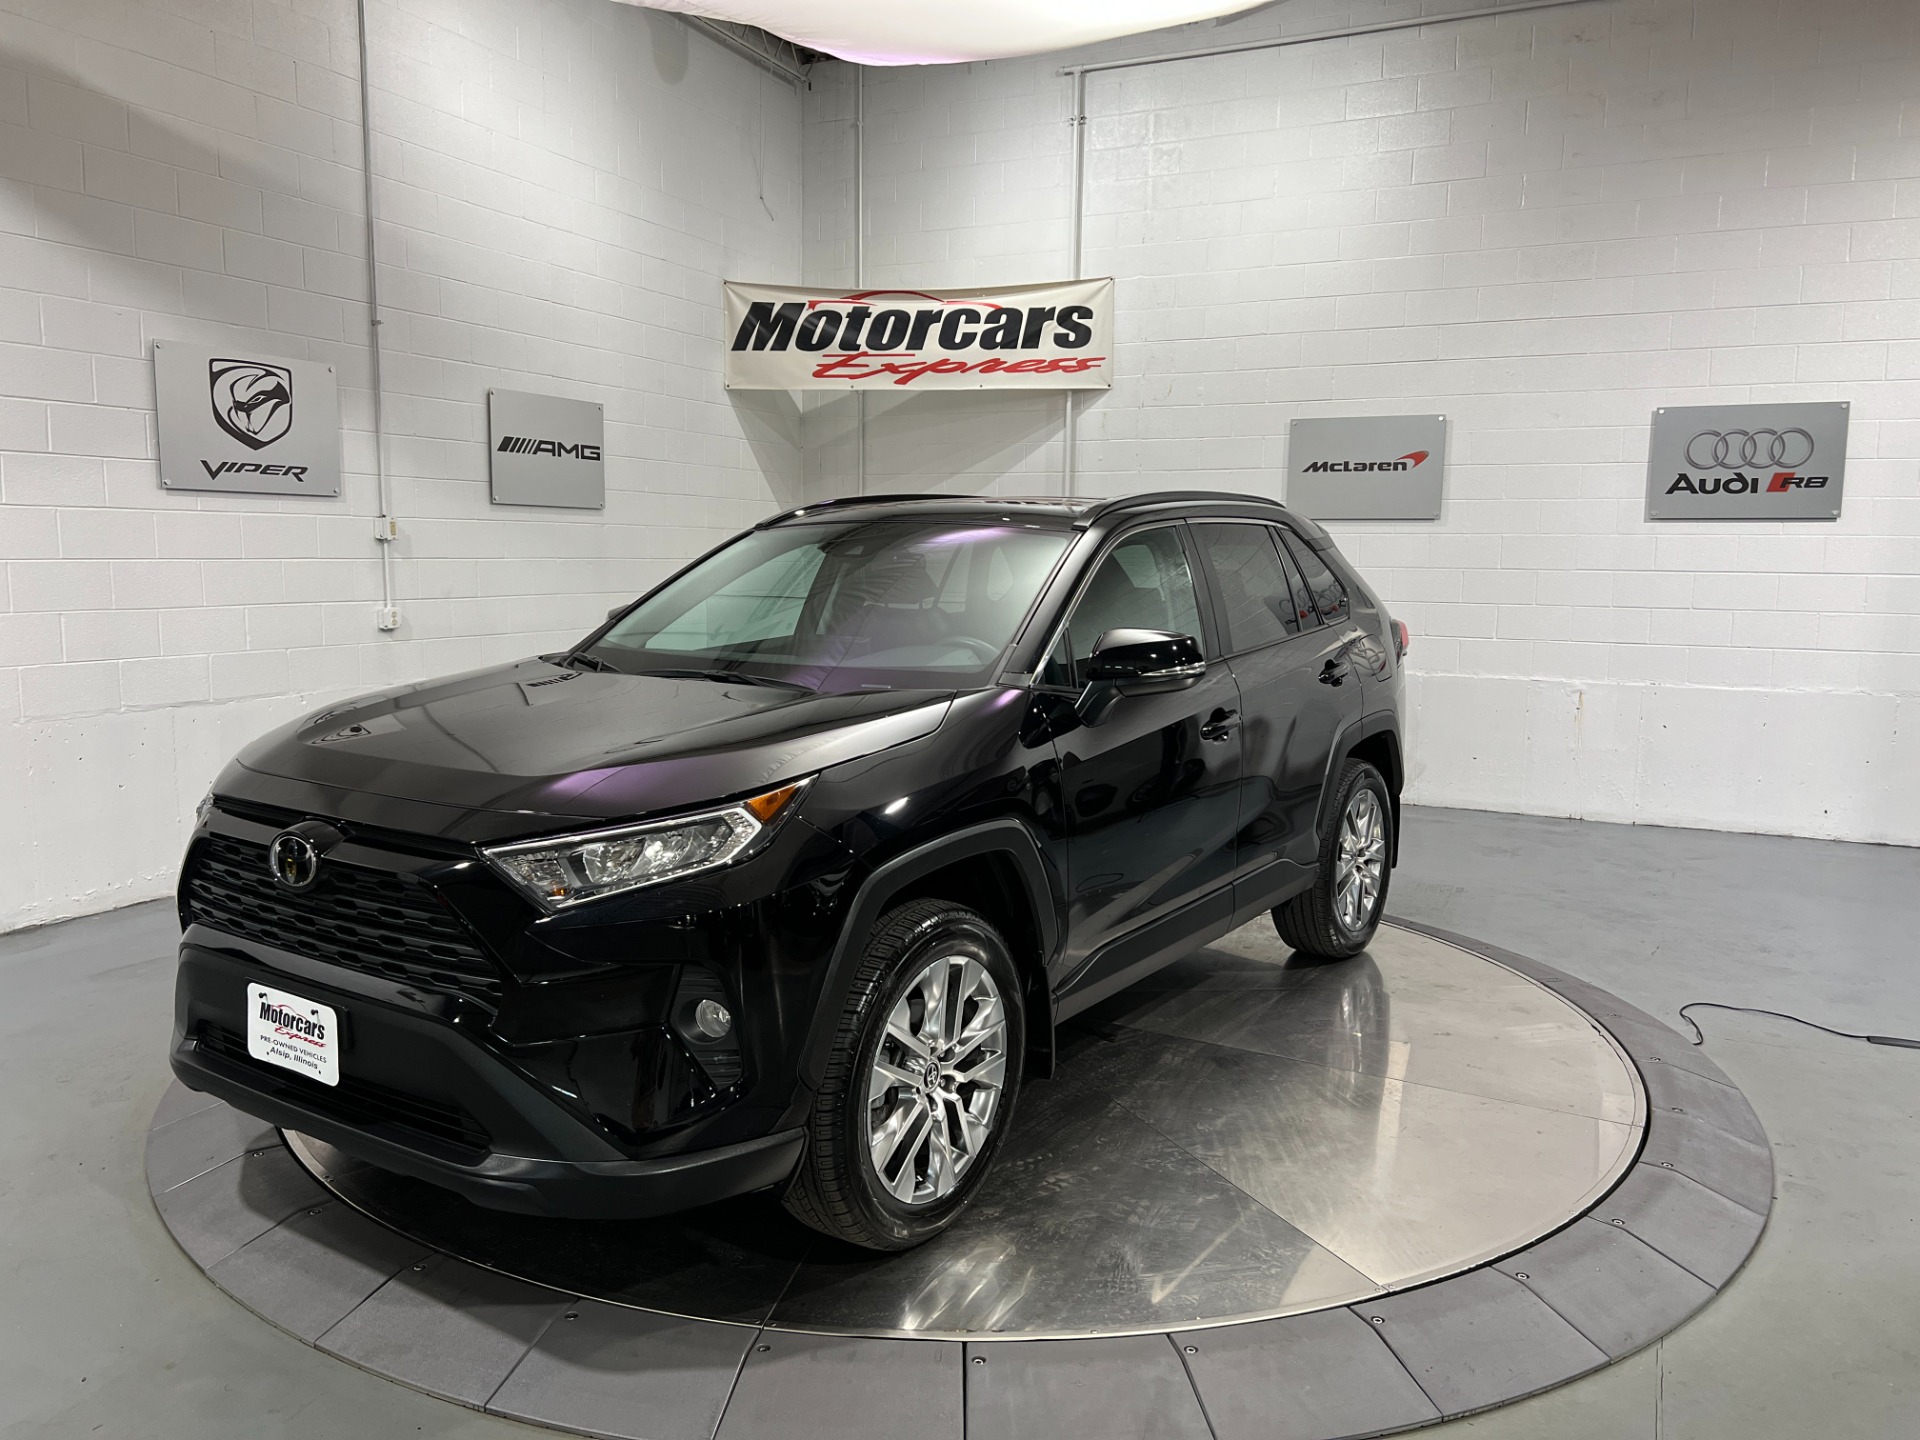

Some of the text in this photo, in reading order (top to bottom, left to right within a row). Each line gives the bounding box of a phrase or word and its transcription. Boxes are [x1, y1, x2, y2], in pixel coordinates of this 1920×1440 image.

[731, 302, 1093, 351] Motorcars
[812, 351, 1106, 385] Express
[532, 440, 601, 461] AMG
[200, 460, 309, 482] VIPER
[1302, 461, 1407, 472] McLaren
[1665, 472, 1759, 494] Audi
[259, 1002, 325, 1040] Motorcars
[274, 1026, 326, 1048] Express
[260, 1035, 327, 1063] PRE-OWNED VEHICLES
[270, 1046, 318, 1070] Alsip, Illinois
